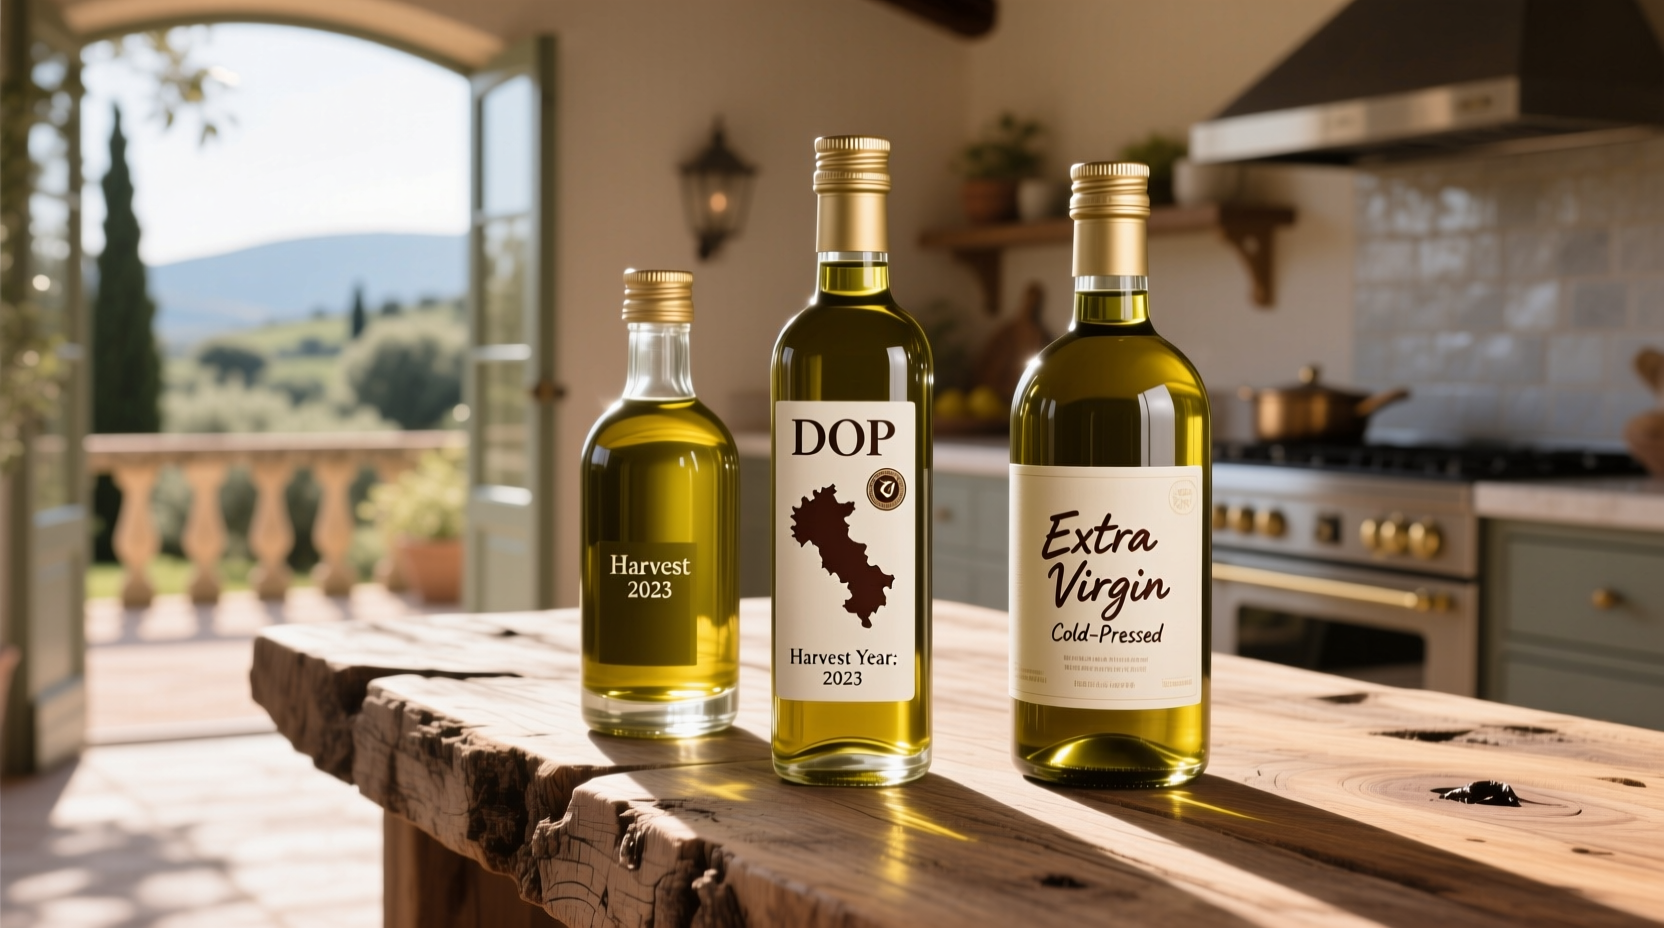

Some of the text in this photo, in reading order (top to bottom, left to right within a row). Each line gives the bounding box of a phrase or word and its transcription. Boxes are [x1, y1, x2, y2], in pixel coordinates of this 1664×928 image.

[791, 418, 896, 457] DOP
[1041, 510, 1159, 560] Extra
[609, 554, 692, 576] Harvest
[627, 580, 672, 599] 2023
[1047, 560, 1171, 622] Virgin
[1051, 622, 1165, 644] Cold-Pressed
[790, 647, 898, 667] Harvest Year:
[822, 670, 863, 687] 2023
